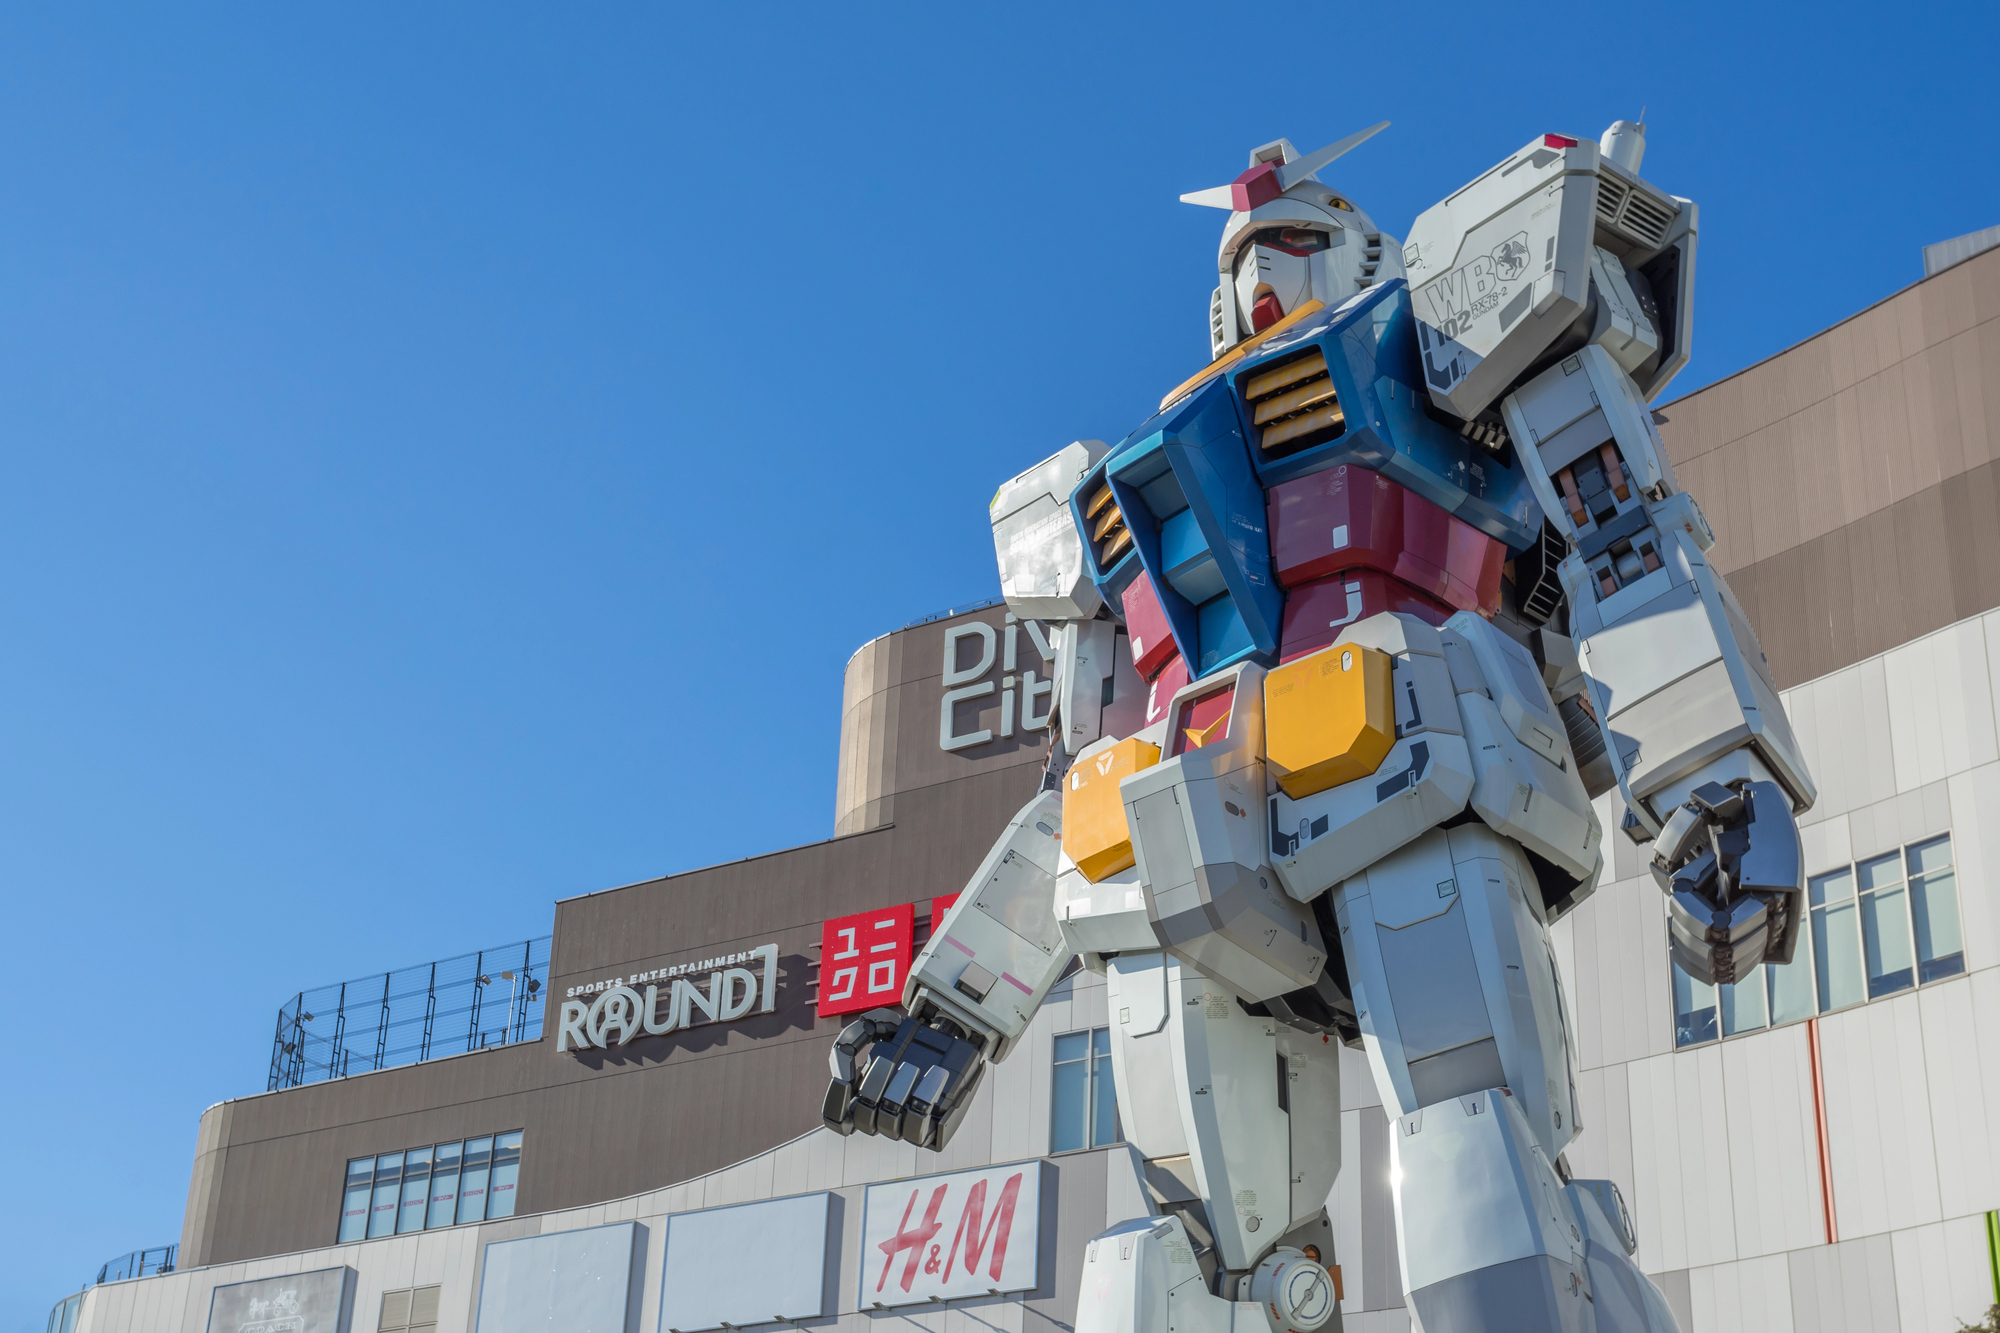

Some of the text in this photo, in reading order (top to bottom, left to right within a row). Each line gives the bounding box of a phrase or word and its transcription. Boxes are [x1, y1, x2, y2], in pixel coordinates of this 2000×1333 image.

[1425, 254, 1497, 323] WB
[1470, 286, 1508, 315] RX-78-2
[1472, 301, 1500, 321] GUNDAM
[833, 919, 897, 961] ユニ
[566, 950, 757, 999] SPORTS ENTERTAINMENT
[829, 959, 896, 1002] クロ
[877, 1172, 1023, 1294] H&M
